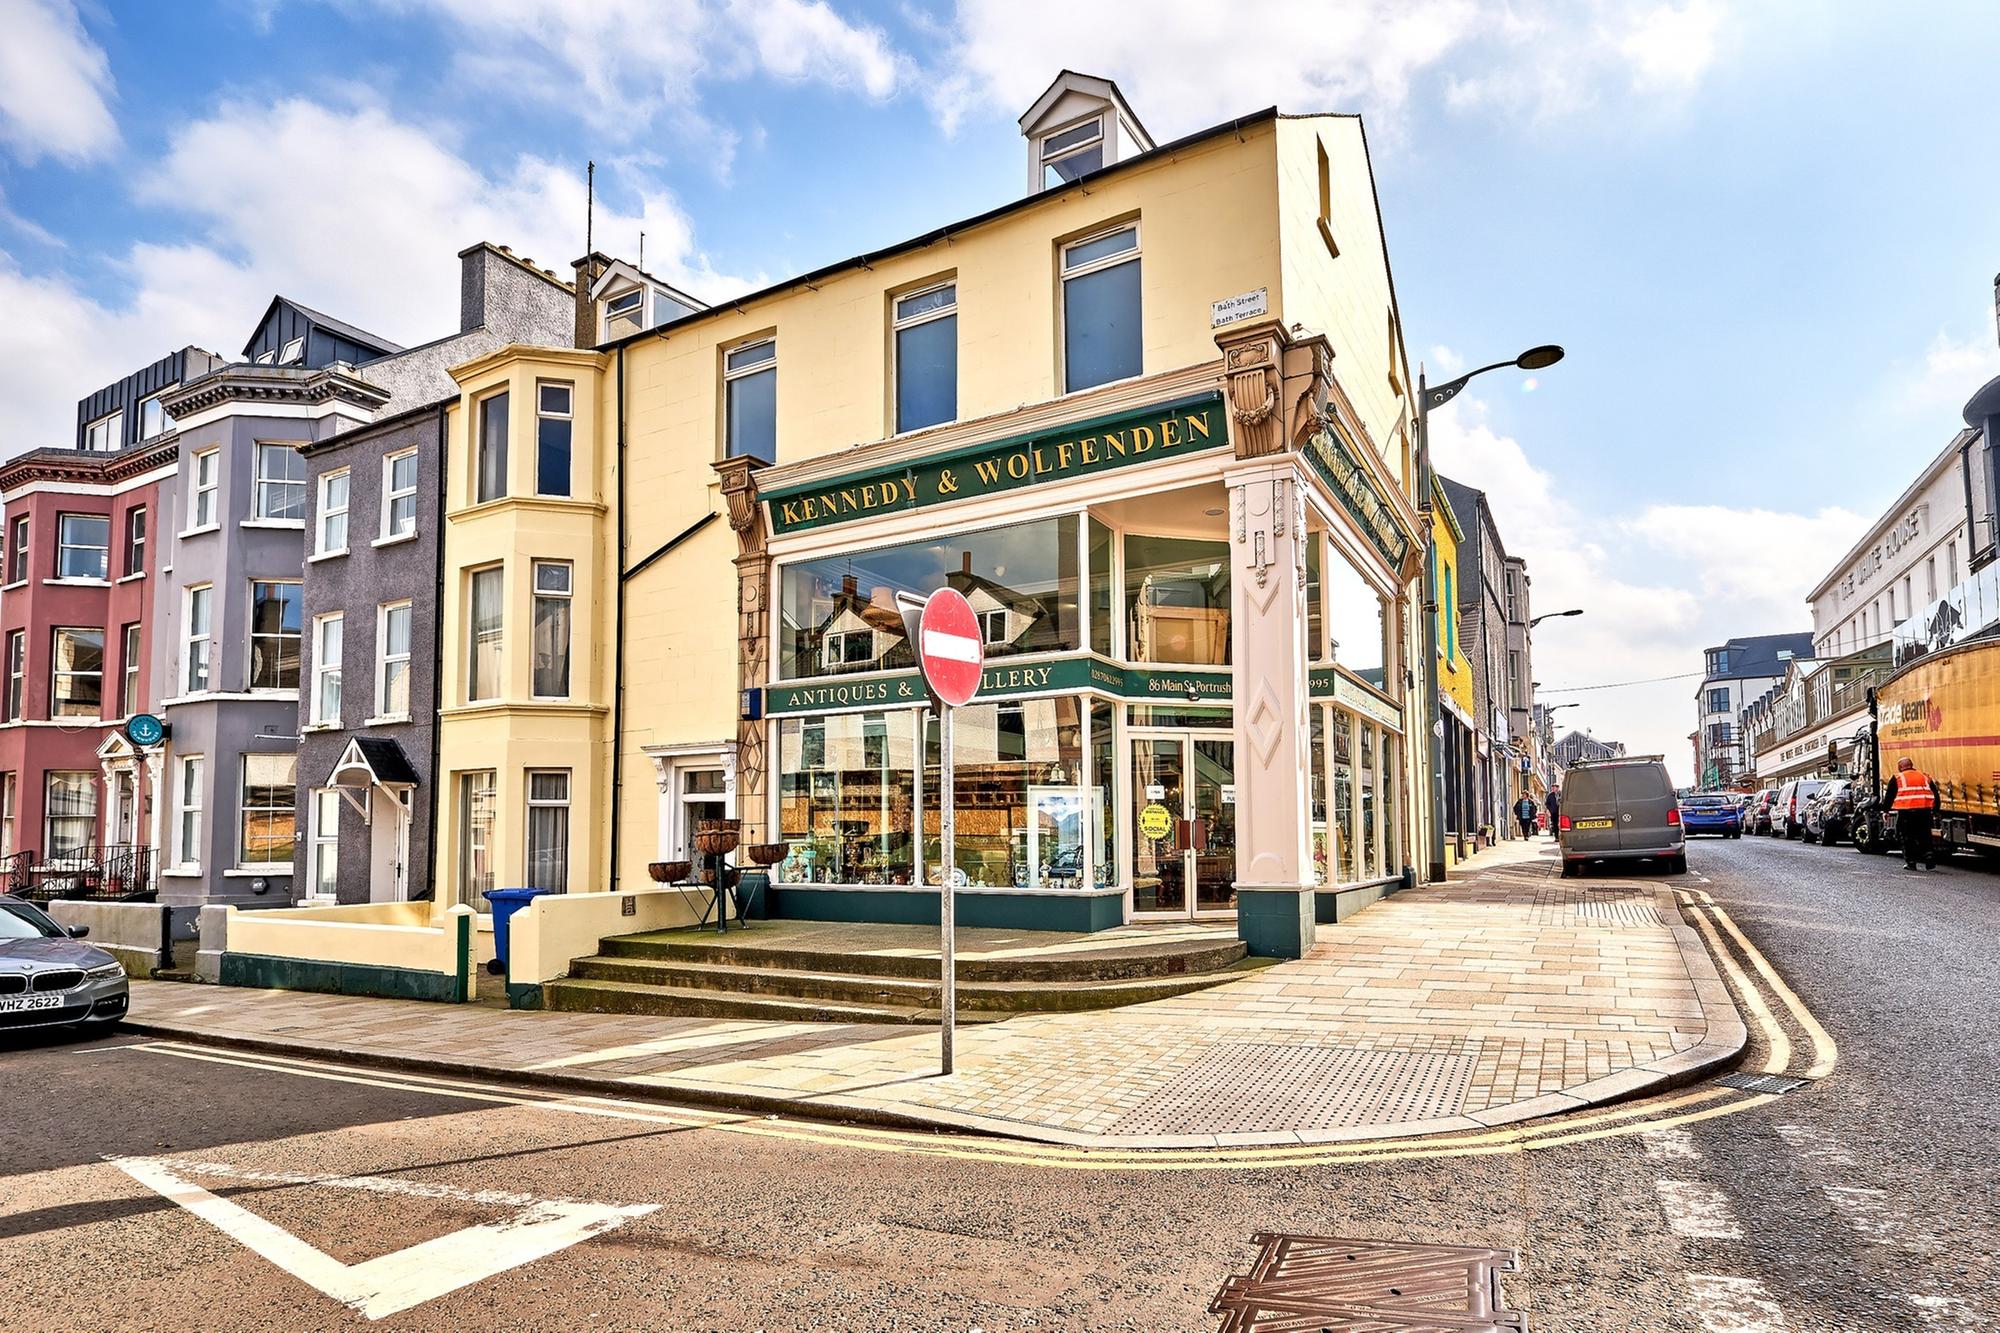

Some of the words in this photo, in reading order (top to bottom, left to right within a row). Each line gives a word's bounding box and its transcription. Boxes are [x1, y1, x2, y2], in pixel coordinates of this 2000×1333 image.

[1217, 301, 1235, 311] Bath
[1236, 294, 1260, 305] Street
[1215, 315, 1234, 325] Bath
[1235, 307, 1262, 319] Terrace
[780, 475, 920, 527] KENNEDY
[937, 468, 959, 494] &
[973, 411, 1211, 486] WOLFENDEN
[1885, 507, 1919, 559] HOUSE
[788, 681, 888, 706] ANTIQUES
[898, 681, 914, 697] &
[1148, 678, 1160, 692] 86
[1161, 679, 1183, 692] Main
[1195, 680, 1232, 693] Portrush
[27, 997, 60, 1009] 2622
